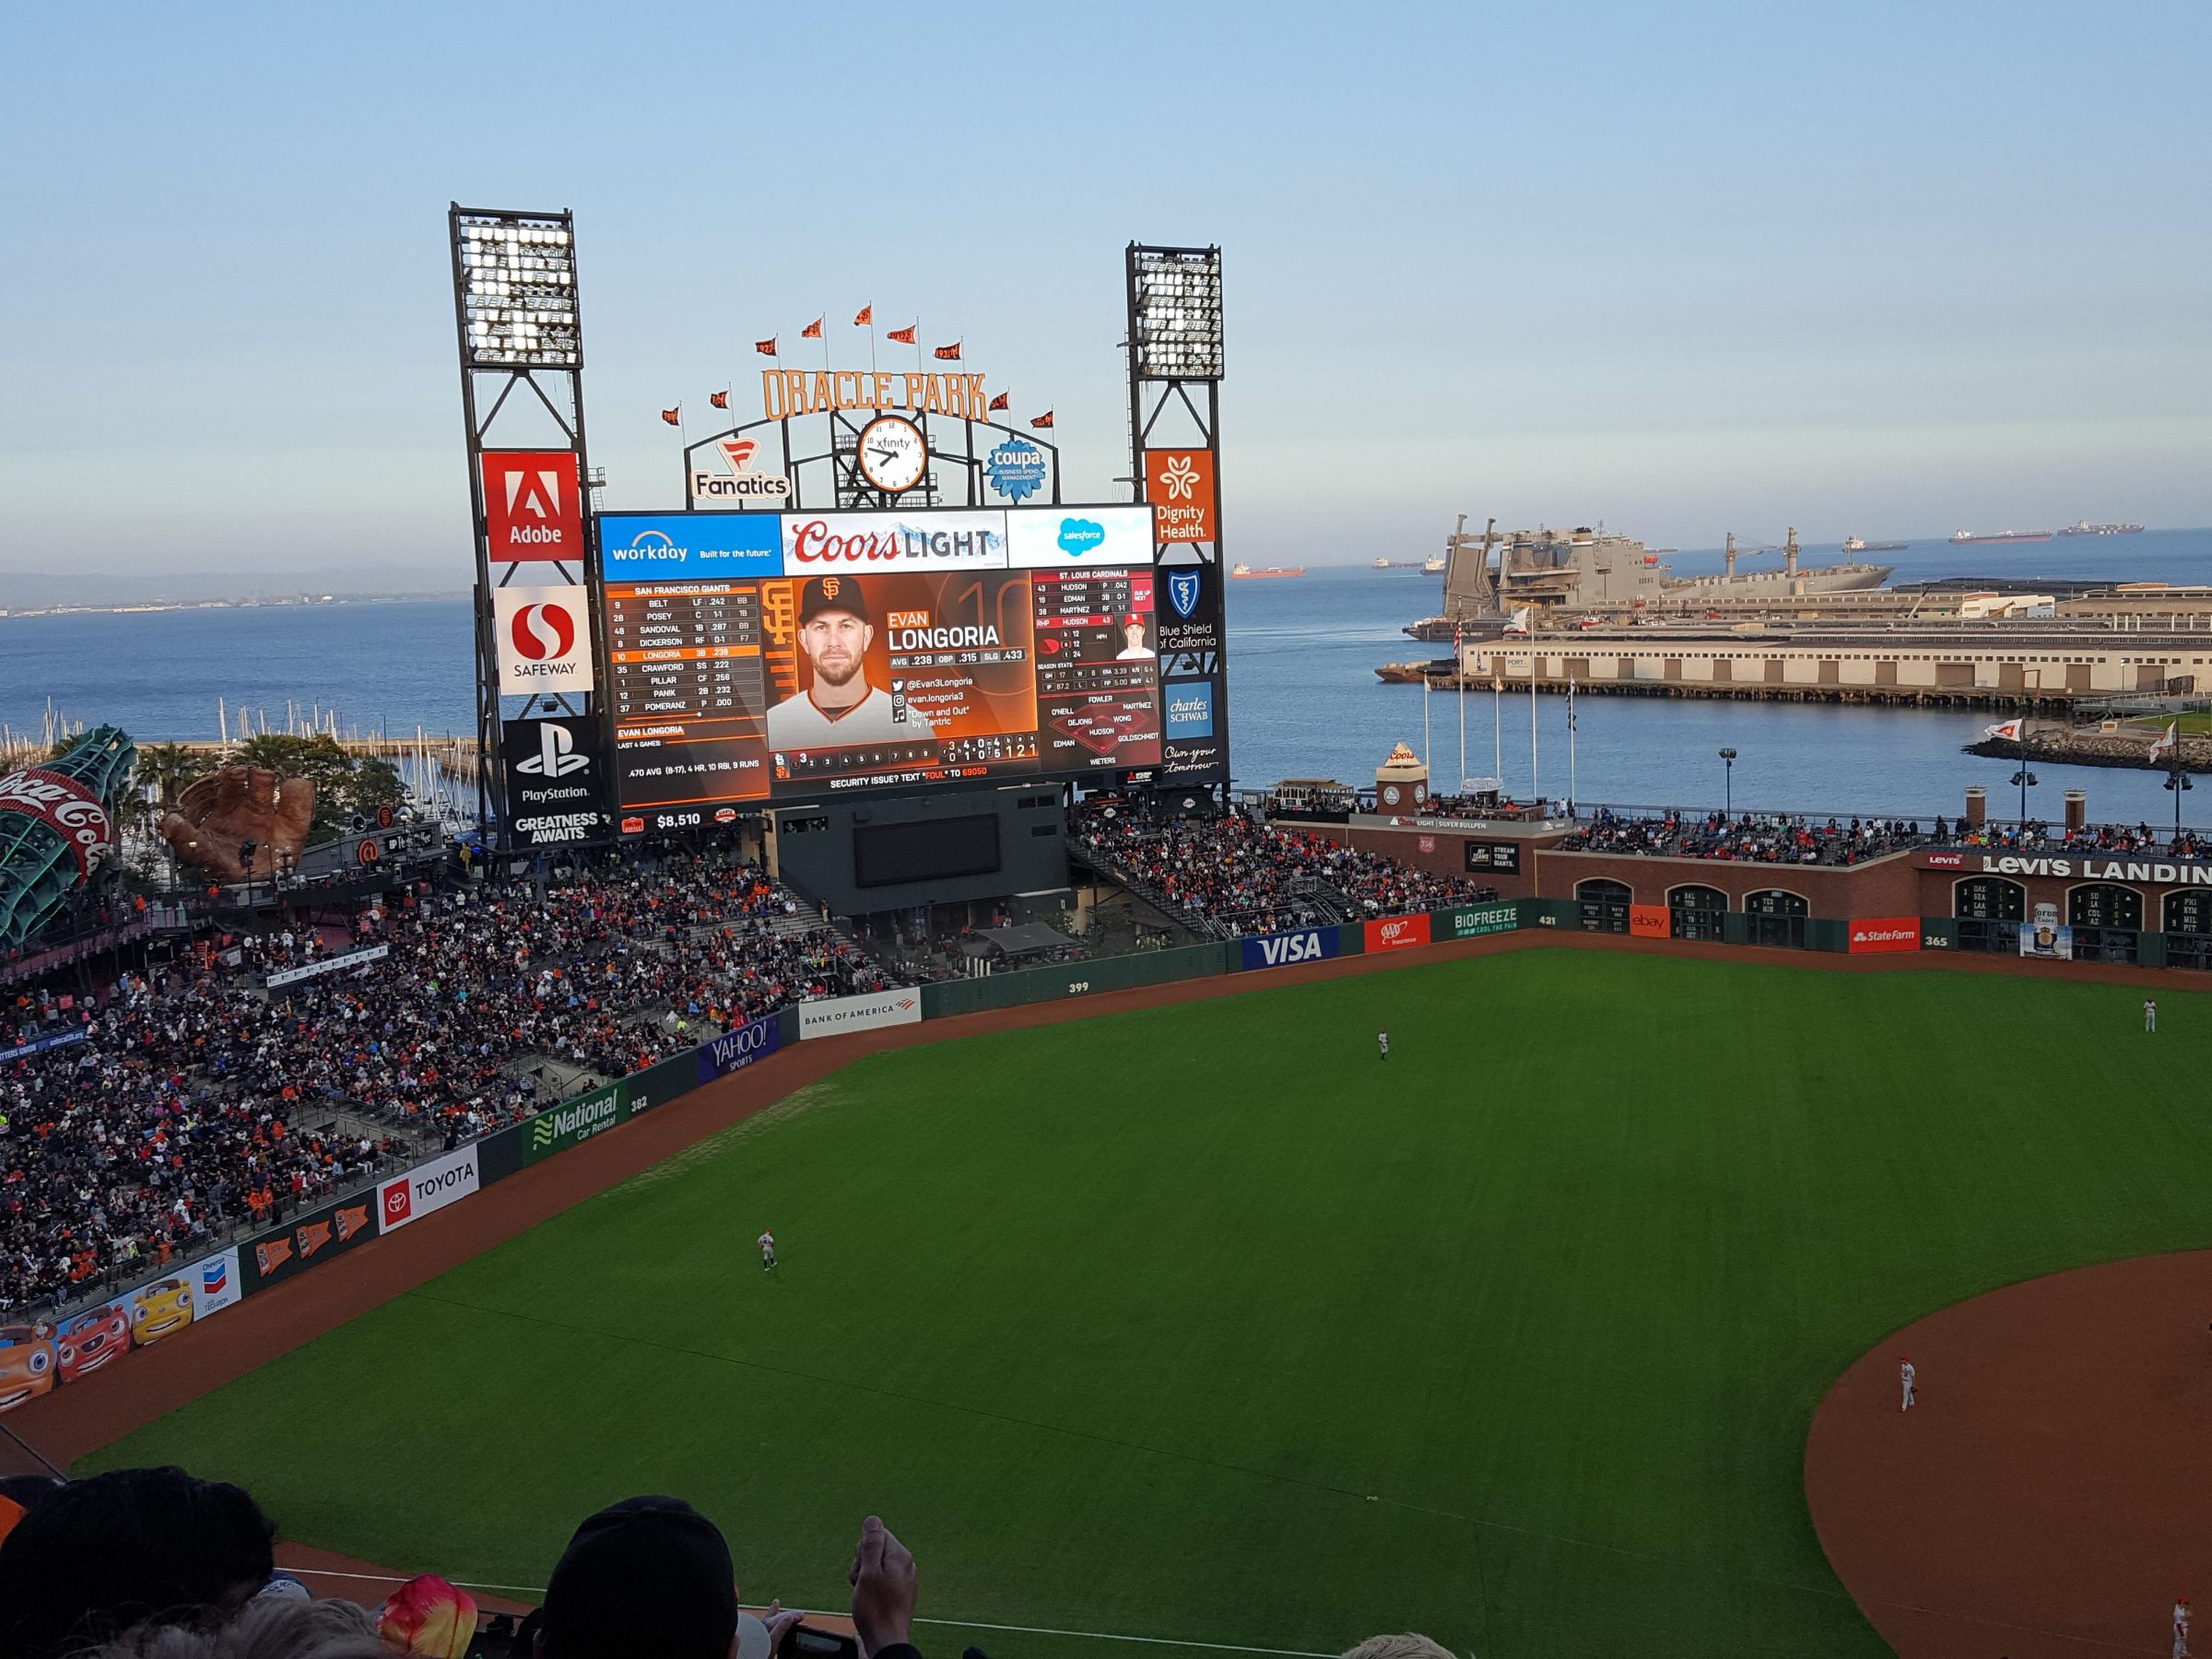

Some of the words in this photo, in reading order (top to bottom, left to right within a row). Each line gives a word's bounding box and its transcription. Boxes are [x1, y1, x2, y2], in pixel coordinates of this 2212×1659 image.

[762, 370, 893, 421] ORACLE
[903, 371, 989, 424] PARK
[877, 437, 910, 450] xfinity
[995, 452, 1041, 469] coupa
[696, 475, 787, 495] Fanatics
[1157, 505, 1205, 524] Dignity
[510, 525, 561, 544] Adobe
[1063, 531, 1101, 541] salesforce
[793, 520, 900, 563] Coors
[905, 530, 989, 558] LIGHT
[612, 544, 688, 562] workday
[1092, 570, 1127, 578] CARDINALS
[654, 586, 699, 594] FRANCISCO
[701, 584, 730, 593] GIANTS
[649, 600, 668, 608] BELT
[693, 598, 702, 606] LF
[889, 612, 927, 627] EVAN
[641, 626, 680, 634] SANDOVAL
[1159, 626, 1180, 636] Blue
[1182, 623, 1212, 635] Shield
[640, 638, 682, 647] DICKERSON
[888, 625, 999, 651] LONGORIA
[1169, 636, 1217, 649] California
[643, 652, 680, 660] LONGORIA
[912, 655, 932, 665] .238
[959, 653, 976, 663] .315
[1003, 650, 1022, 660] .433
[514, 663, 576, 677] SAFEWAY
[641, 664, 684, 673] CRAWFORD
[651, 677, 677, 685] PILLAR
[907, 677, 973, 690] @Evan3Longoria
[908, 692, 964, 703] evan.longoria3
[645, 701, 686, 711] POMERANZ
[935, 707, 950, 716] and
[1171, 698, 1207, 712] charles
[912, 720, 922, 729] by
[924, 717, 951, 726] Tantric
[1068, 718, 1092, 726] DEJONG
[1171, 712, 1207, 723] SCHWAB
[618, 729, 640, 737] EVAN
[642, 725, 684, 735] LONGORIA
[1118, 733, 1159, 742] GOLDSCHMIDT
[800, 753, 806, 762] 3
[1165, 747, 1187, 759] Own
[1189, 747, 1217, 762] your
[1390, 749, 1415, 759] Coors
[1090, 757, 1115, 765] WIETERS
[1164, 760, 1218, 773] tomorrow
[646, 768, 662, 776] AVG
[830, 778, 869, 789] SECURITY
[871, 775, 899, 785] ISSUE?
[900, 772, 920, 782] TEXT
[950, 770, 960, 778] TO
[962, 767, 987, 776] 69050
[522, 787, 588, 803] PlayStation
[515, 812, 598, 831] GREATNESS
[657, 813, 700, 829] $8,510
[1439, 820, 1458, 829] SILVER
[531, 827, 585, 843] AWAITS
[1455, 908, 1517, 929] BIOFREEZE
[1538, 916, 1556, 925] 421
[1632, 914, 1665, 929] ebay
[1504, 922, 1517, 930] PAIN
[1925, 936, 1947, 947] 365
[1256, 932, 1323, 965] VISA
[1068, 982, 1088, 994] 399
[805, 1015, 832, 1025] BANK
[835, 1012, 849, 1020] OF
[850, 1005, 894, 1018] AMERICA
[712, 1021, 767, 1066] YAHOO!
[730, 1054, 753, 1071] SPORTS
[630, 1095, 647, 1112] 382
[554, 1088, 617, 1138] National
[578, 1129, 590, 1140] Car
[592, 1114, 616, 1134] Rental
[416, 1163, 475, 1200] TOYOTA
[203, 1257, 225, 1271] Chevron
